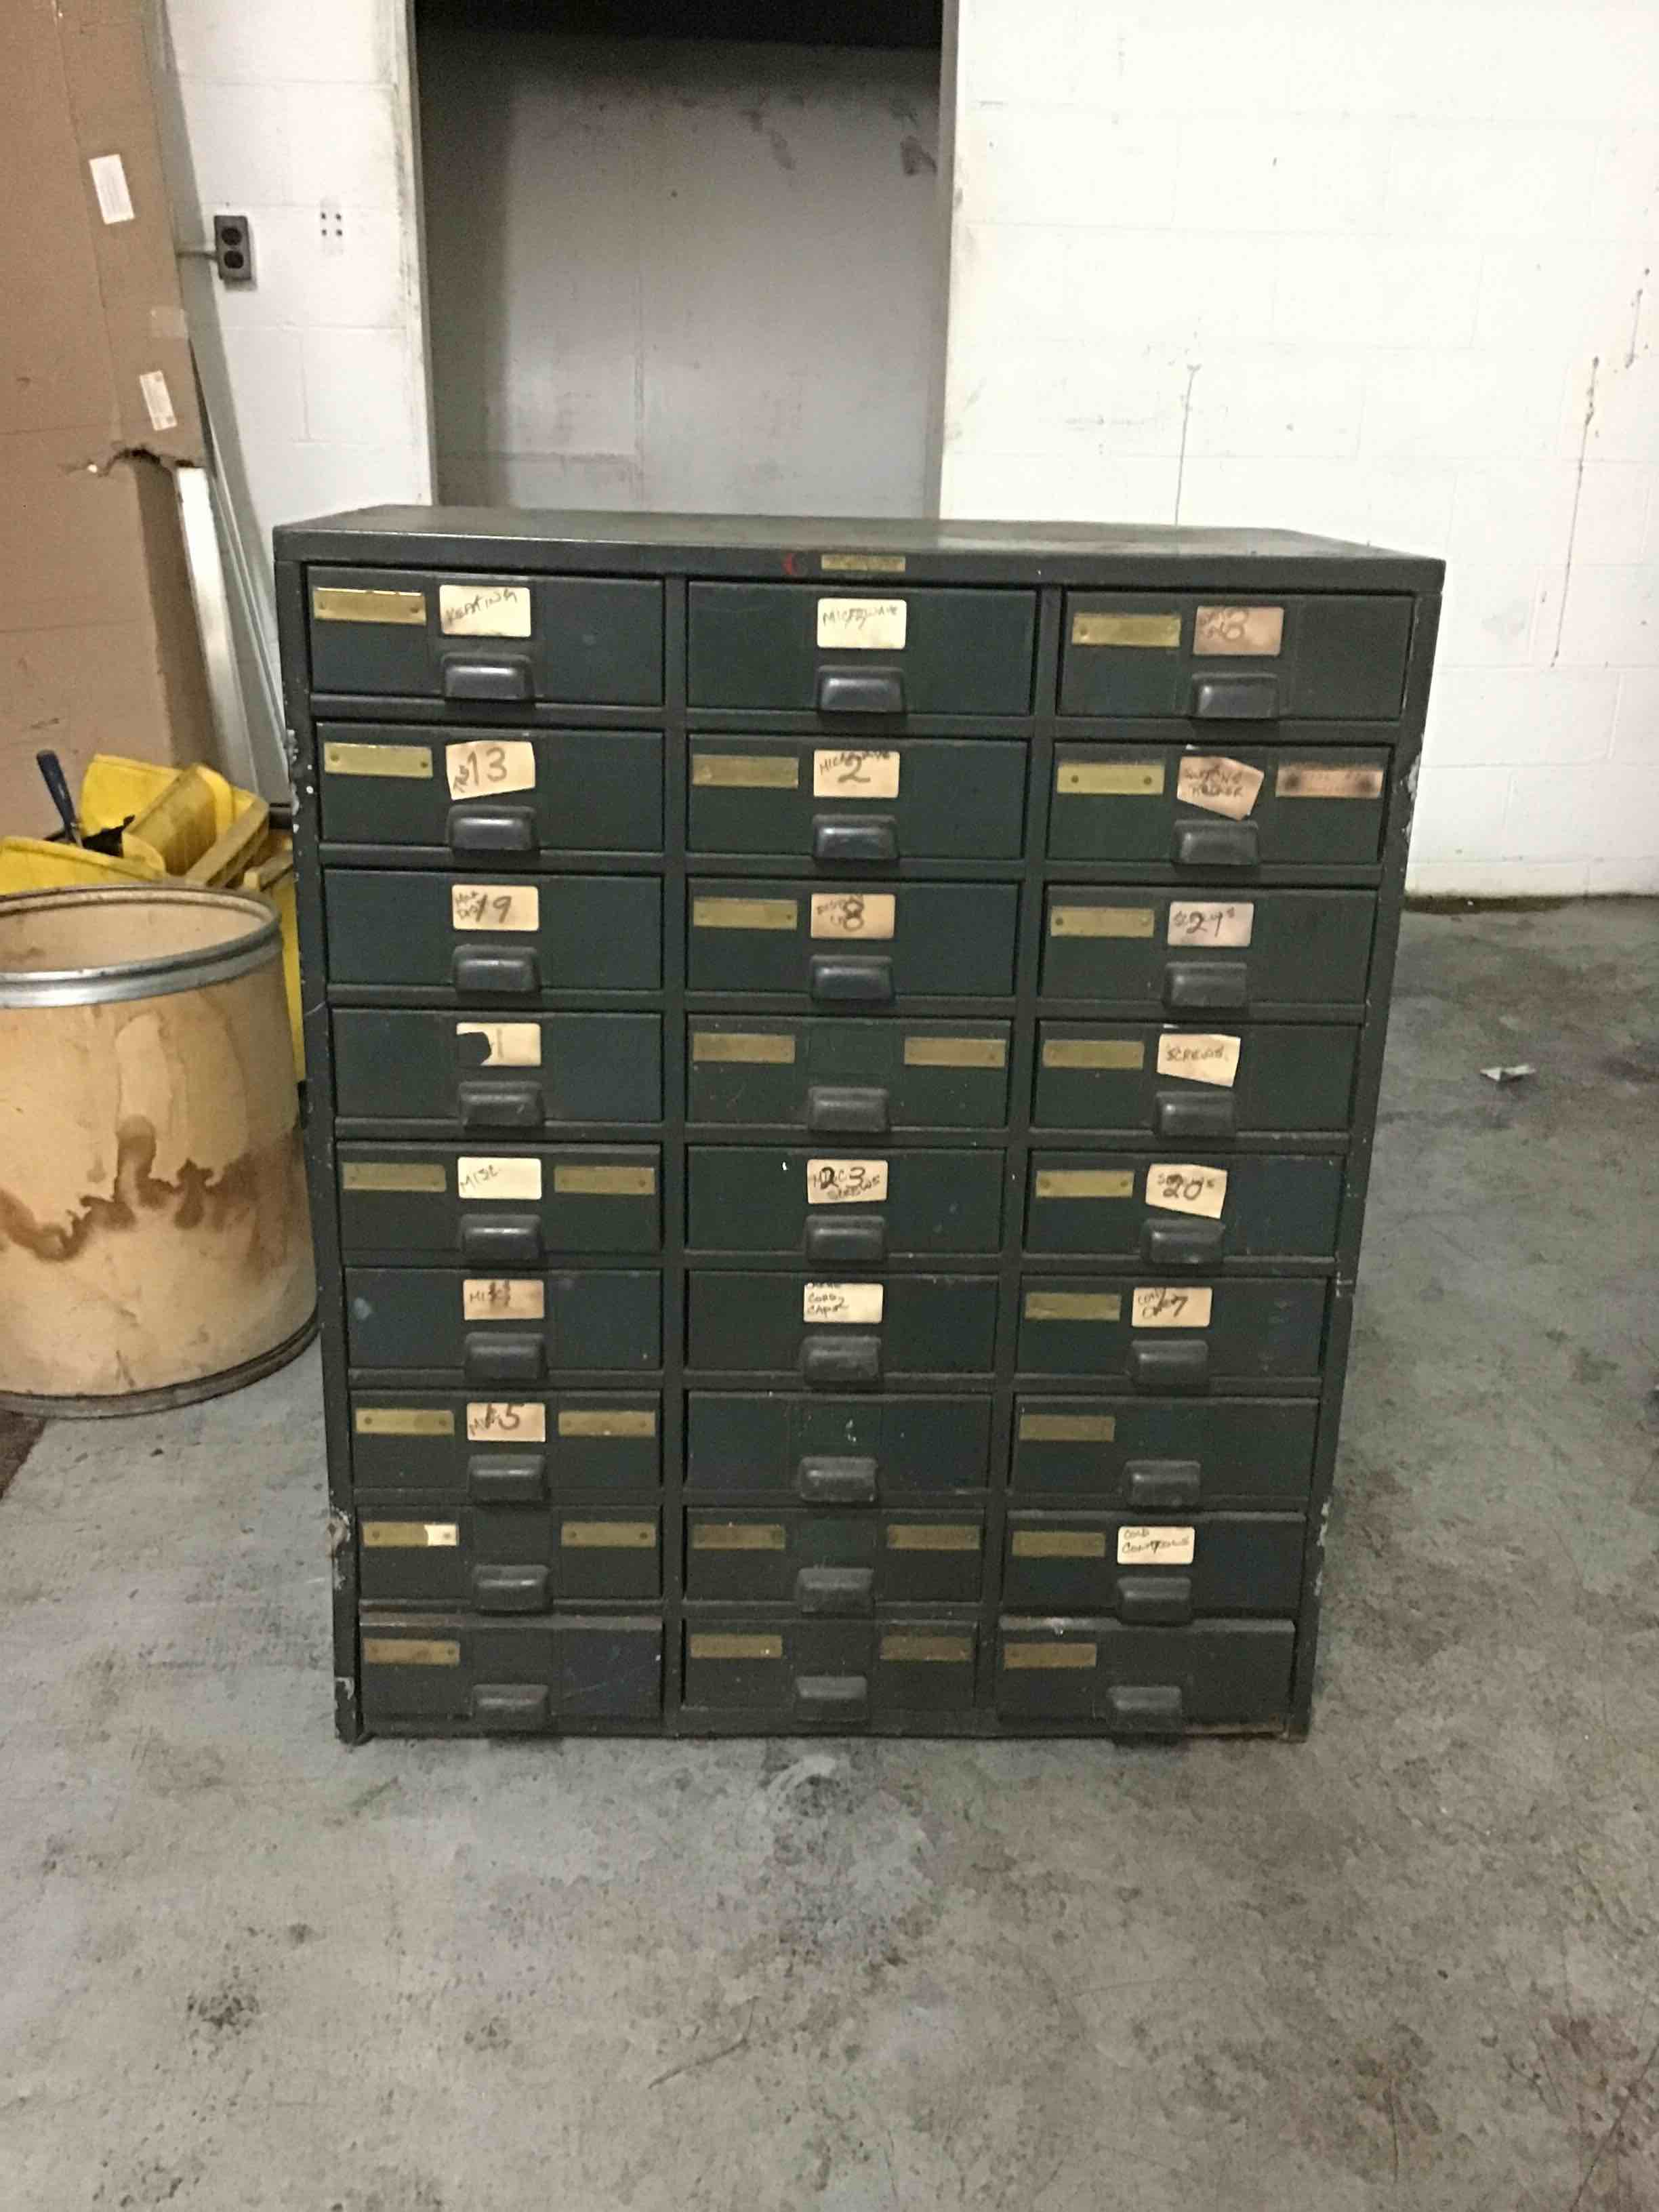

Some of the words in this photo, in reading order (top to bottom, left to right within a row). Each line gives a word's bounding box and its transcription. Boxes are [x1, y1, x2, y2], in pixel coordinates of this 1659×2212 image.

[467, 747, 507, 785] 13
[838, 753, 871, 783] 2
[476, 893, 512, 924] 19
[1163, 1174, 1204, 1201] 20
